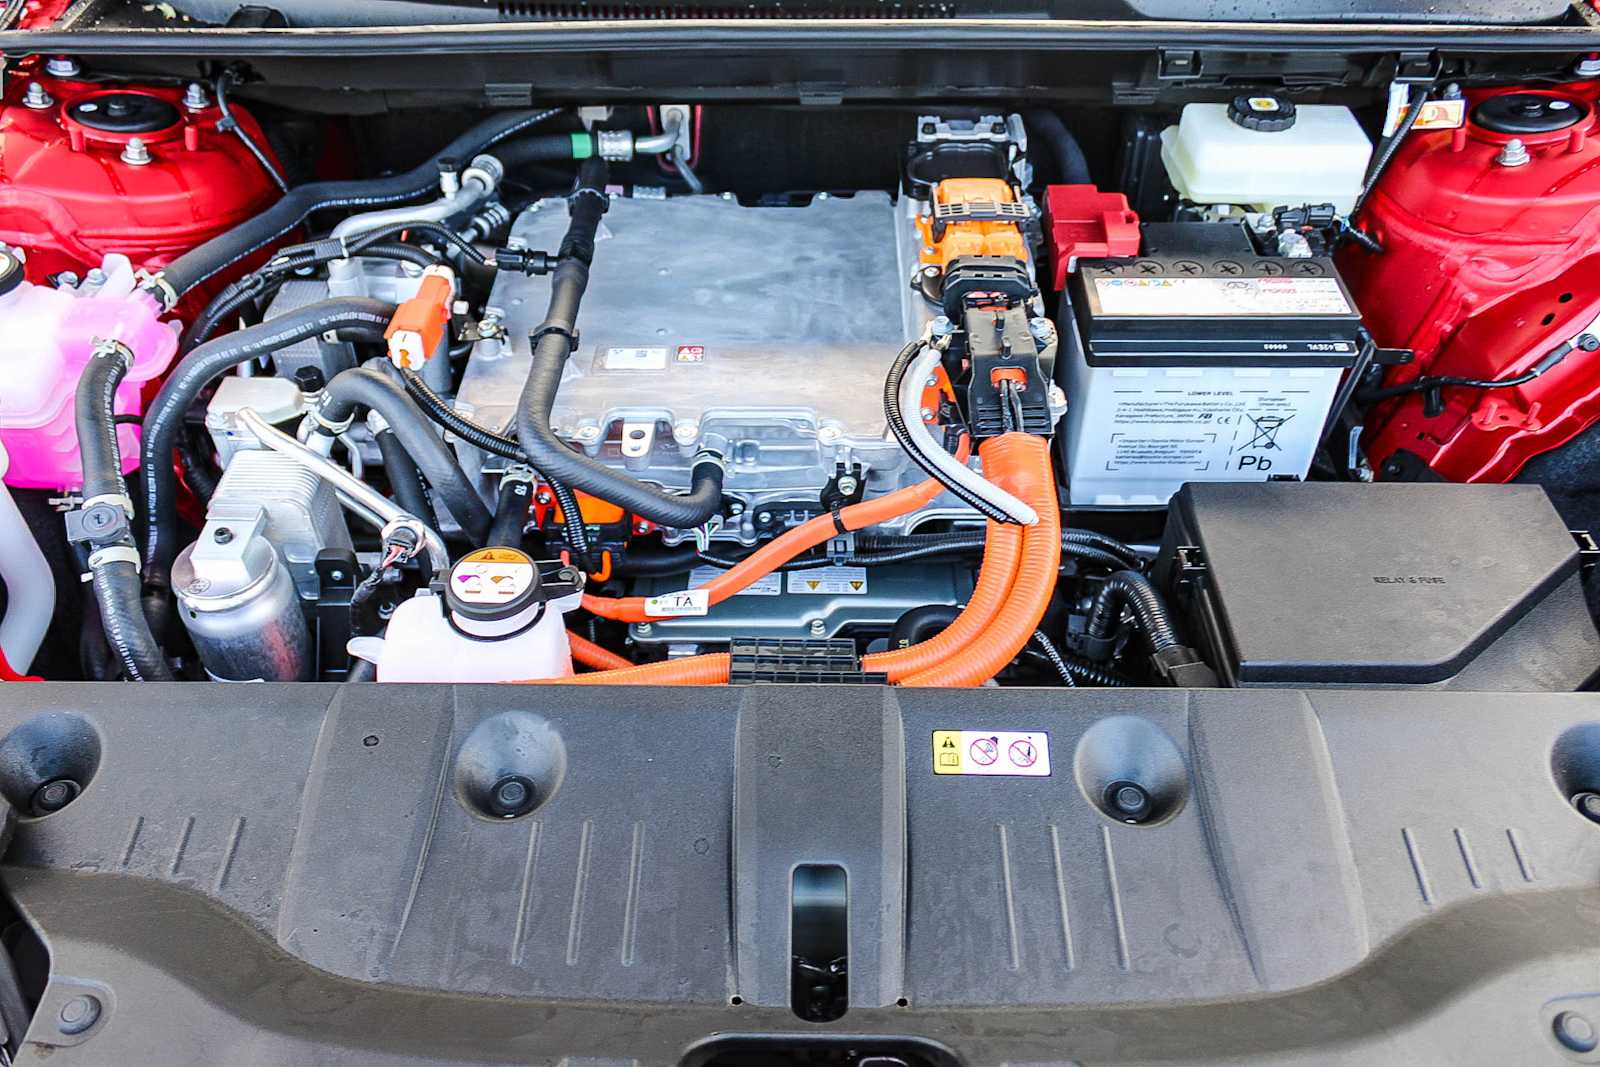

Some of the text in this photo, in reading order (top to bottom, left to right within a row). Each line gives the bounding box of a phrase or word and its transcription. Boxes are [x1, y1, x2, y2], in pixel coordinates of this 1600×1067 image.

[1238, 455, 1272, 471] Pb
[1373, 576, 1406, 584] RELAY
[673, 596, 693, 607] TA
